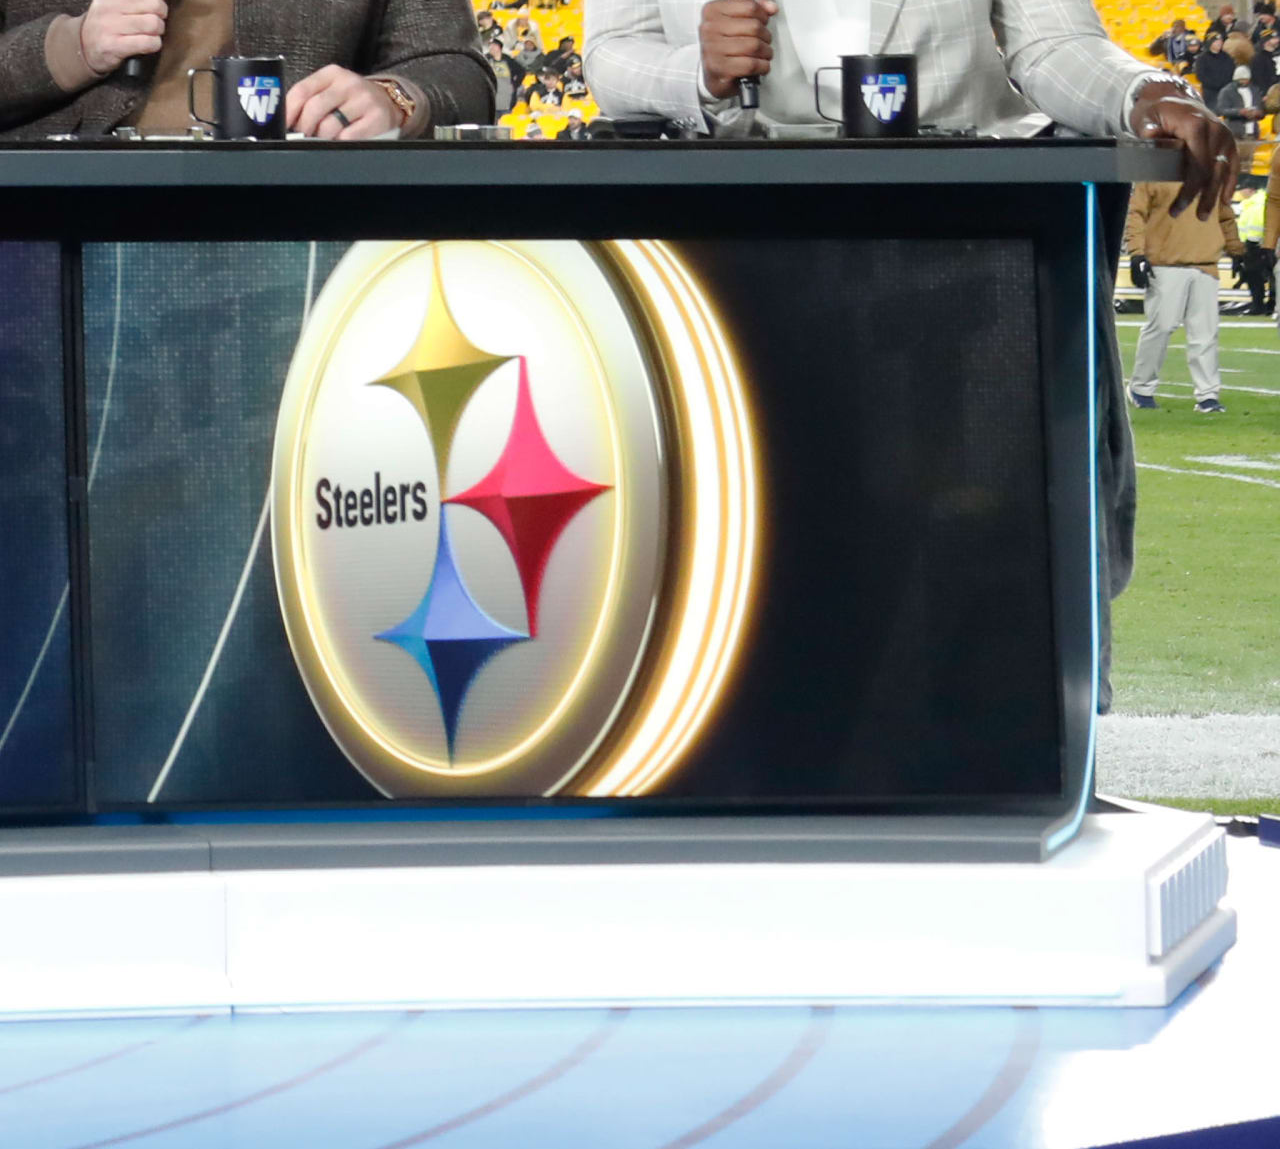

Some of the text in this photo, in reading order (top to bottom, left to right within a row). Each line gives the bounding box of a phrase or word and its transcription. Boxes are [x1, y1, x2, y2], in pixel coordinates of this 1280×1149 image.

[237, 87, 281, 123] TNF
[860, 84, 908, 121] TNF
[315, 471, 428, 531] Steelers
